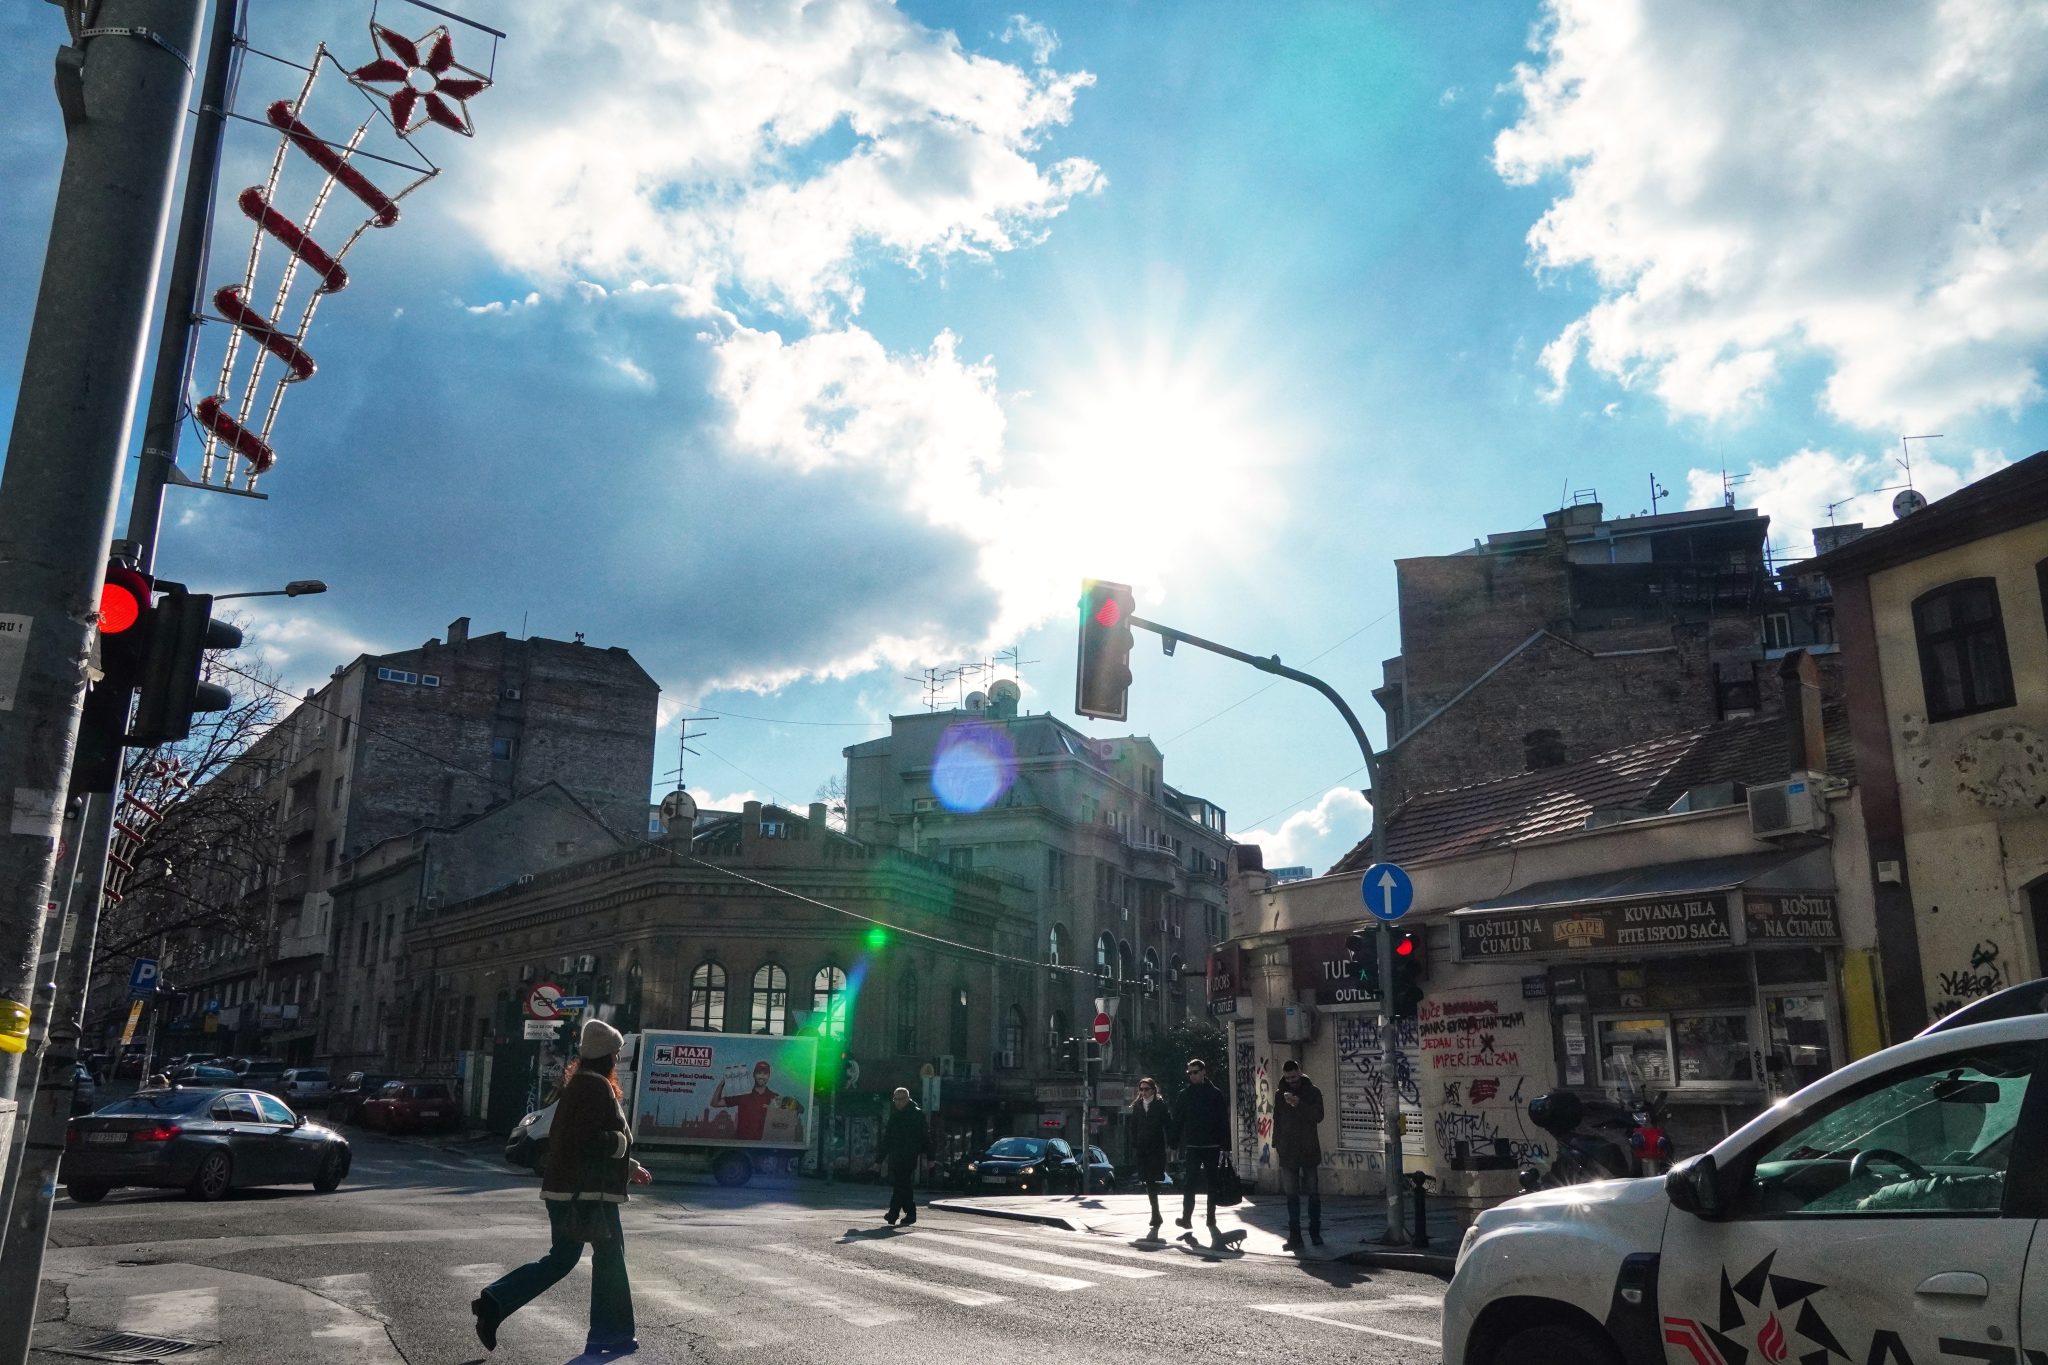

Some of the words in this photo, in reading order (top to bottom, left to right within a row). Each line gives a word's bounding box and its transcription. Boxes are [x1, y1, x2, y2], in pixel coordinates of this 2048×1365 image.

[1624, 904, 1682, 921] KUVANA
[1684, 901, 1716, 921] JELA
[1781, 895, 1831, 919] ROŠTILJ
[1468, 920, 1519, 937] ROŠTILJ
[1522, 919, 1542, 933] NA
[1557, 920, 1601, 937] AGAPE
[1617, 928, 1645, 943] PITE
[1647, 925, 1687, 941] ISPOD
[1690, 919, 1729, 939] SAČA
[1764, 920, 1786, 936] NA
[136, 963, 156, 984] P
[1323, 960, 1351, 980] TUD
[1420, 1020, 1446, 1037] DANAS
[1421, 1037, 1452, 1050] JEDAN
[678, 1047, 709, 1058] MAXI
[676, 1058, 709, 1066] ONLINE
